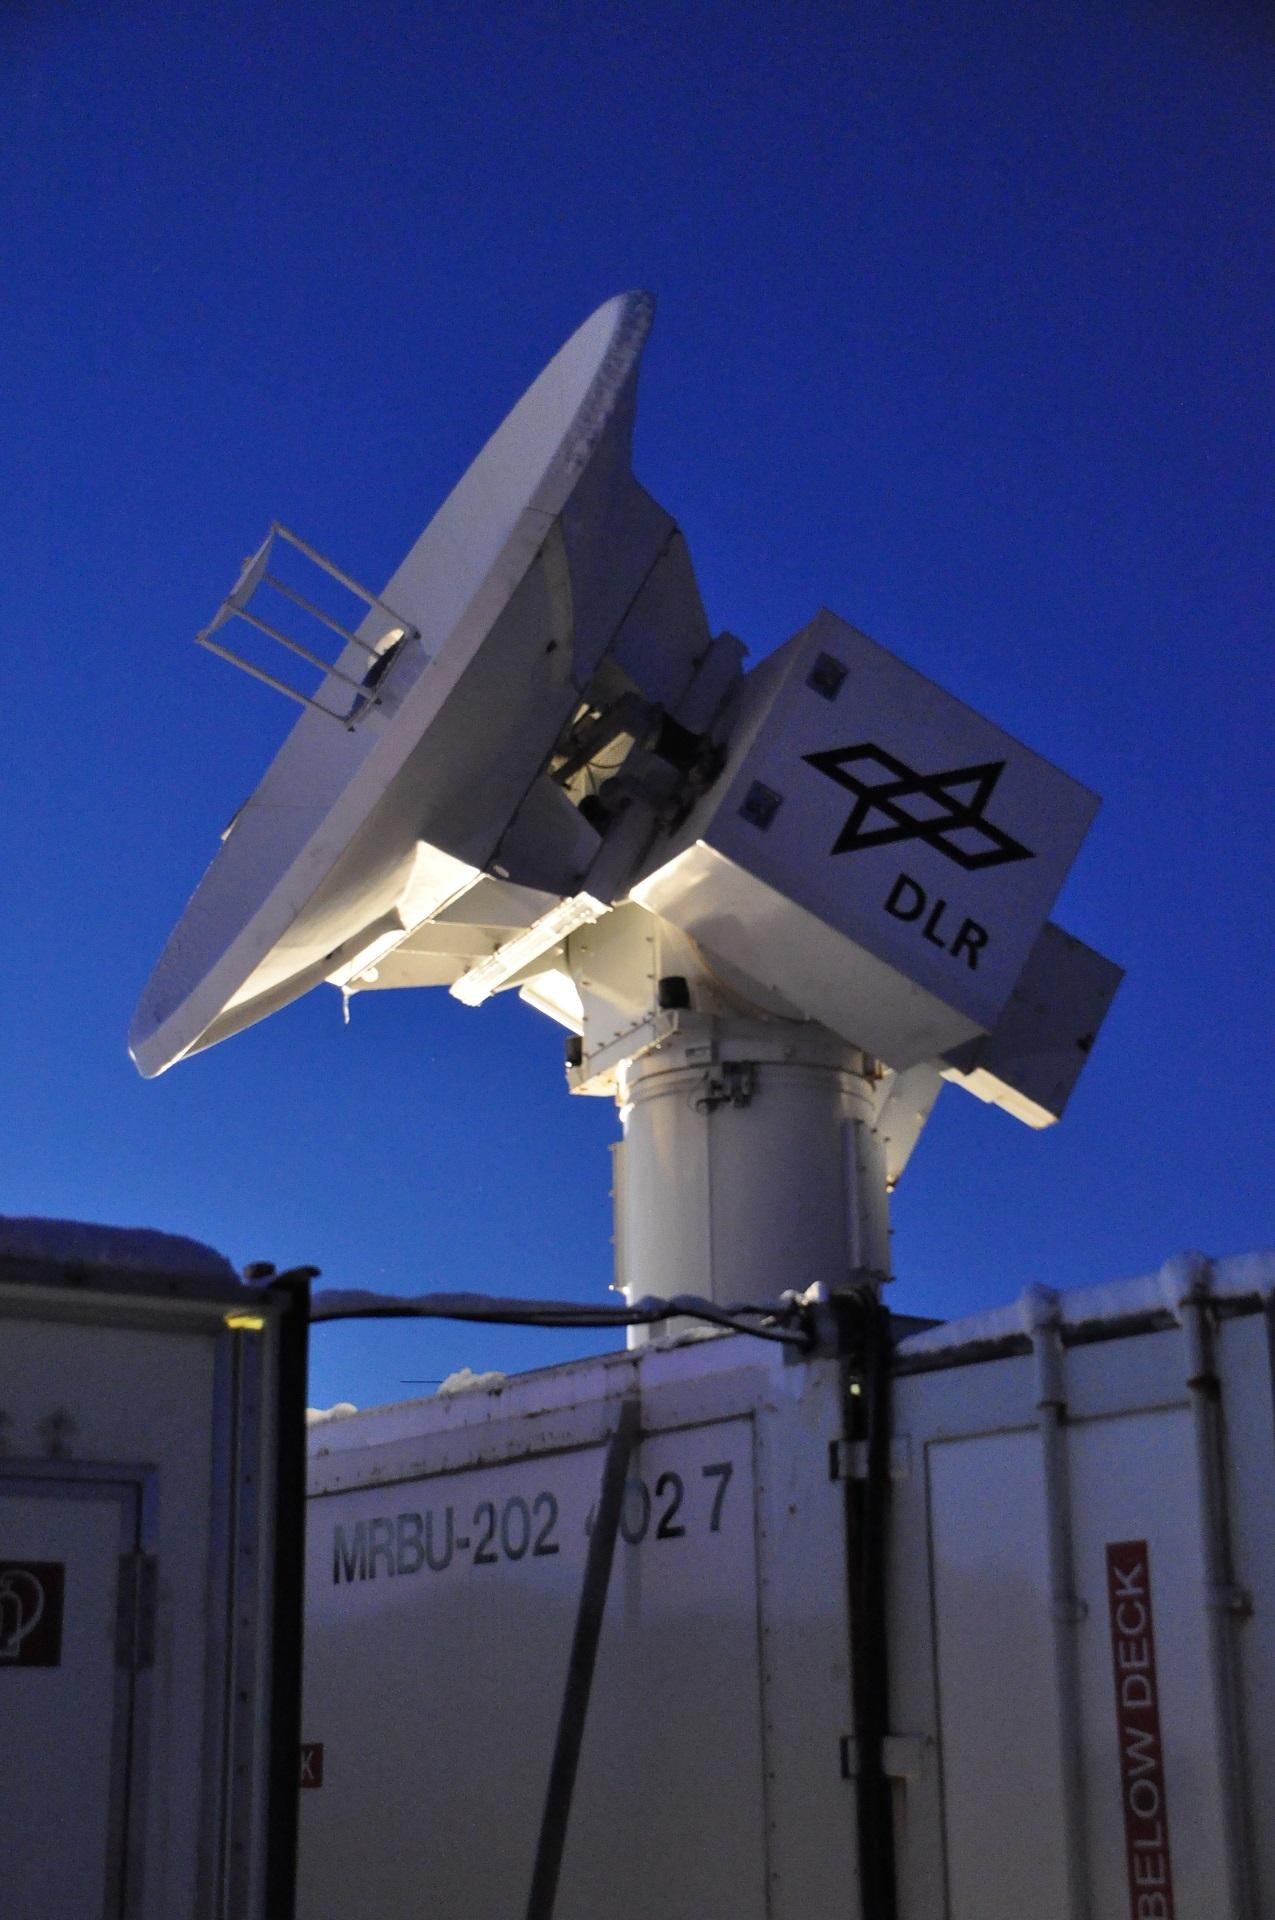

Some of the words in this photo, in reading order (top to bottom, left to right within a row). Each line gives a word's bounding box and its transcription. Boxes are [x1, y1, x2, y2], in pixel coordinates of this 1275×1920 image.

[884, 872, 989, 970] DLR
[333, 1490, 560, 1585] MRBU-202
[584, 1471, 685, 1545] 02
[702, 1461, 734, 1532] 7
[1114, 1561, 1152, 1709] DECK
[1126, 1727, 1168, 1920] BELOW
